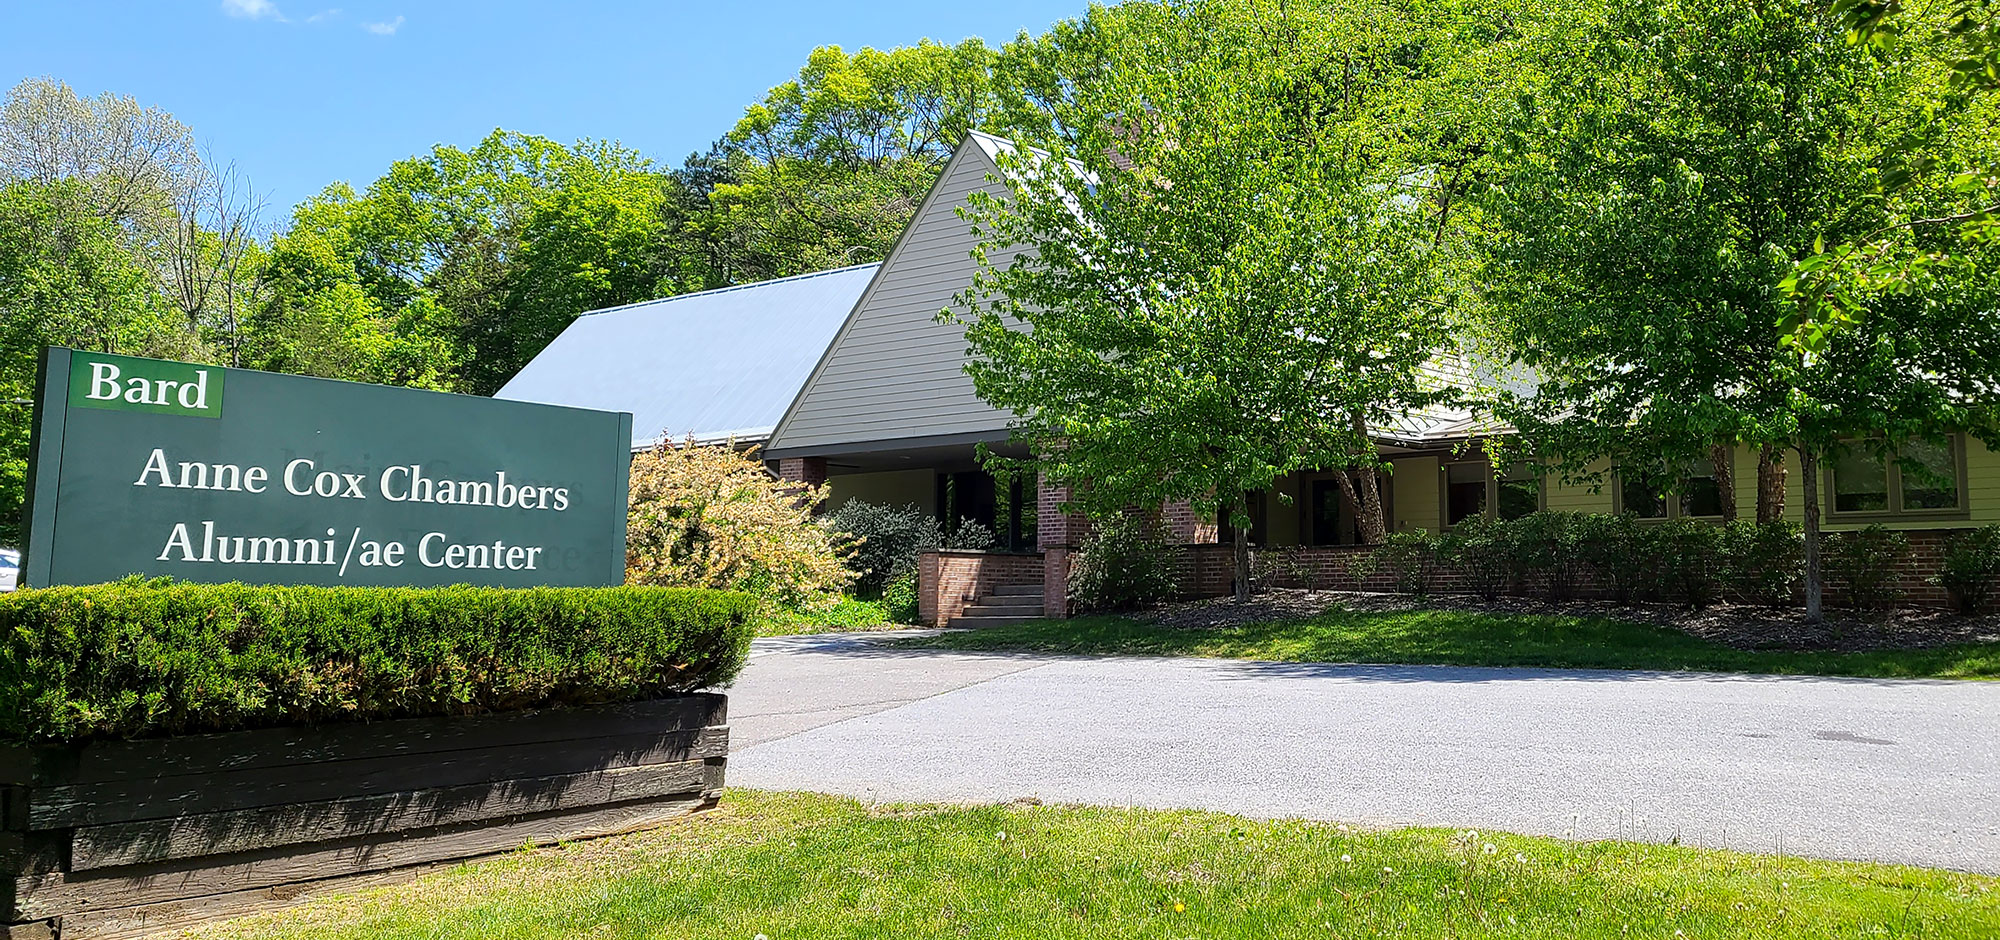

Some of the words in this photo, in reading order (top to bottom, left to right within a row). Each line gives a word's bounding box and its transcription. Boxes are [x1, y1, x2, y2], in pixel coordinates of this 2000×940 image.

[86, 362, 209, 409] Bard
[133, 448, 268, 494] Anne
[283, 458, 367, 499] Cox
[380, 464, 569, 511] Chambers
[156, 521, 405, 577] Alumni/ae
[418, 532, 543, 570] Center
